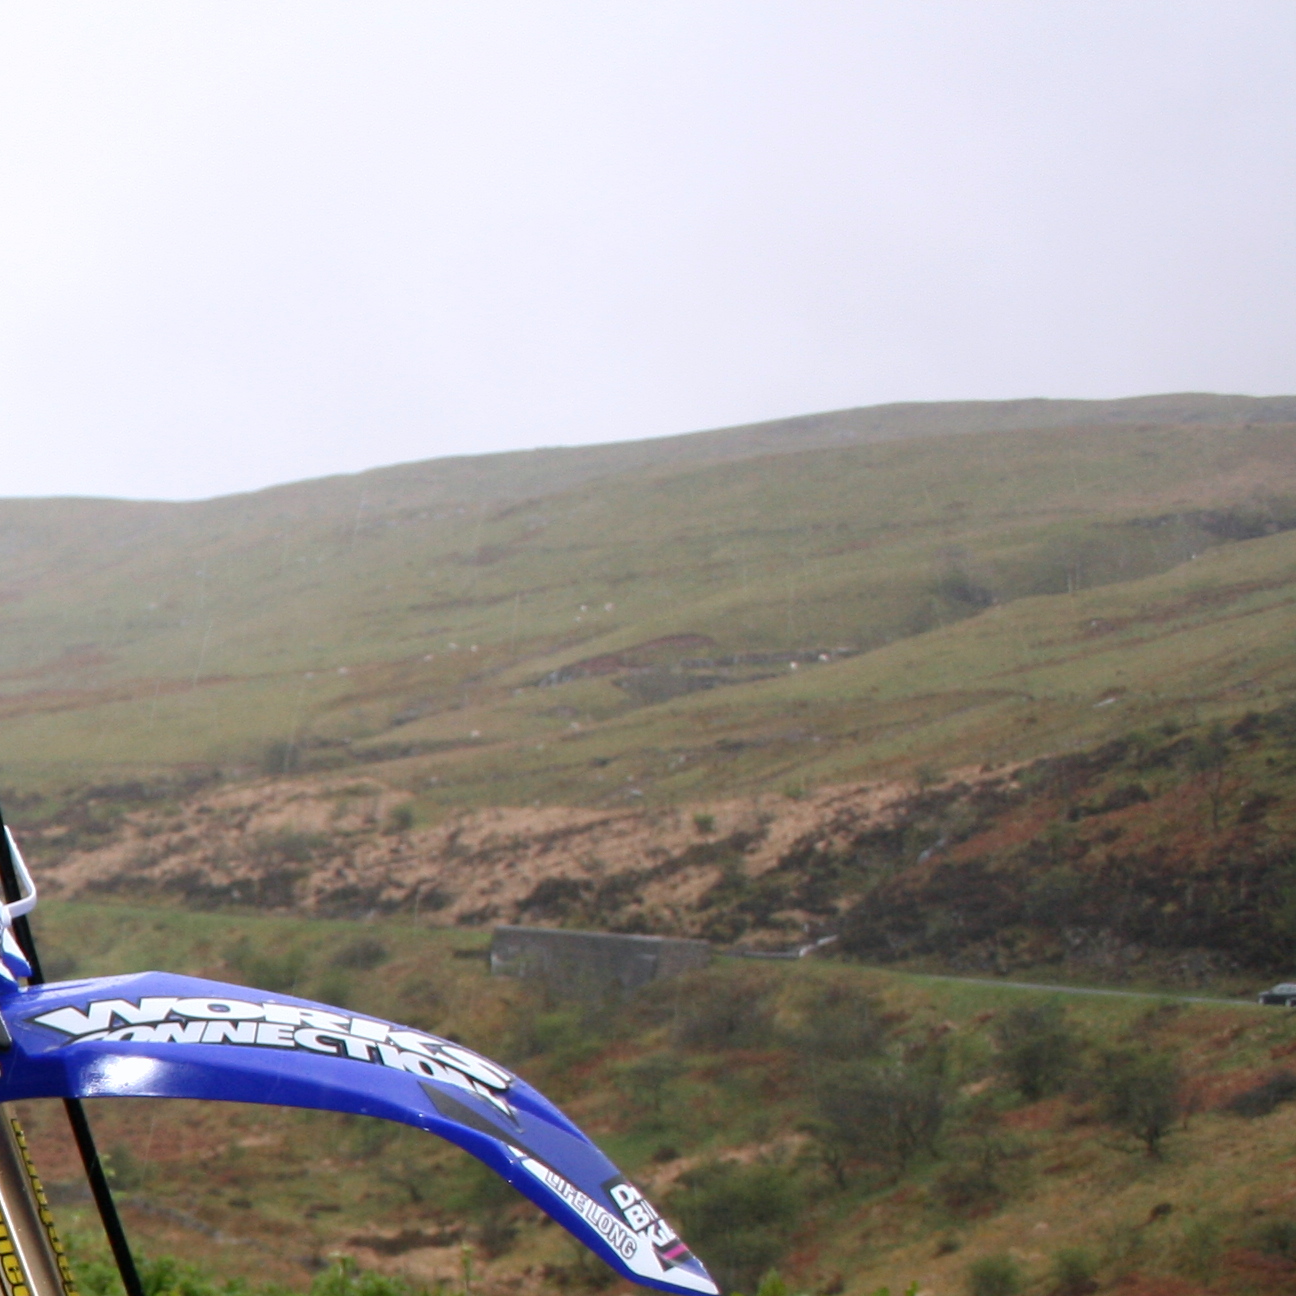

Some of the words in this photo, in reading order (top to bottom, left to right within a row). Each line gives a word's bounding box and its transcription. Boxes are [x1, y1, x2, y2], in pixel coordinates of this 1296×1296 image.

[29, 997, 514, 1094] WORKS
[545, 1170, 586, 1211] LIFE
[585, 1199, 638, 1260] LONG
